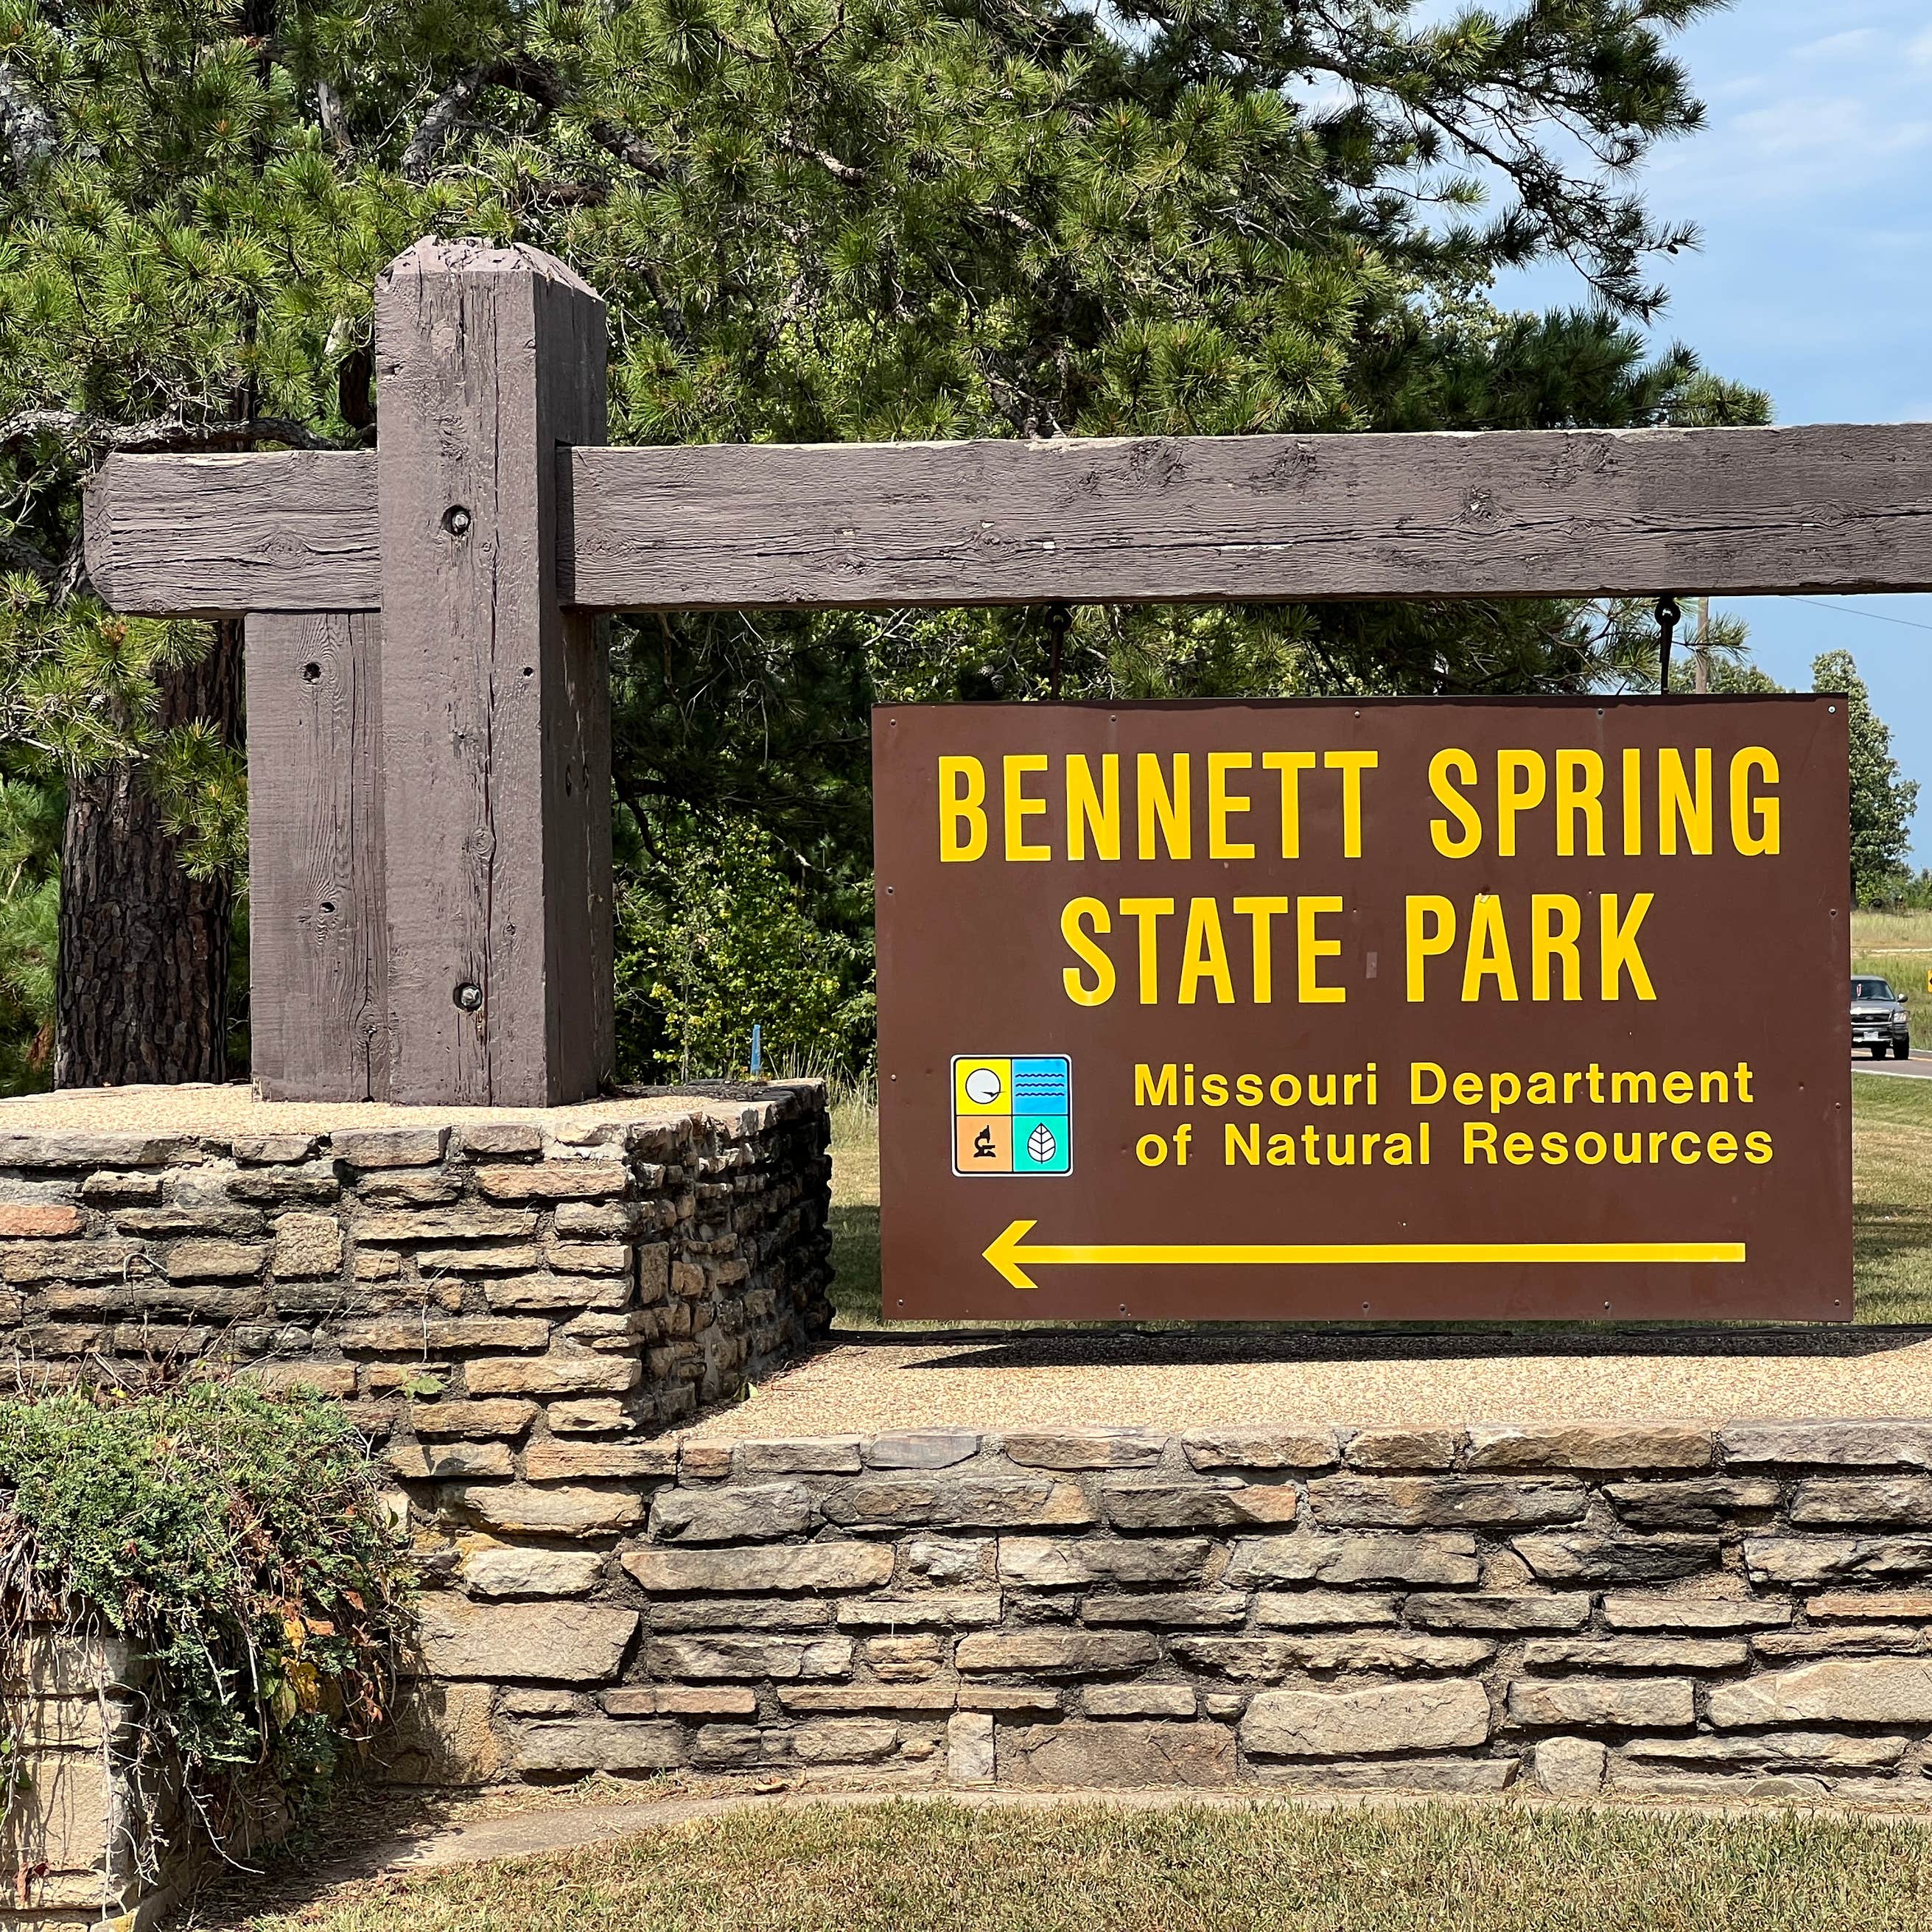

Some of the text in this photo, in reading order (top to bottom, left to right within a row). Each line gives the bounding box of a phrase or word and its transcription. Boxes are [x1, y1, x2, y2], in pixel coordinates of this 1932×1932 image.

[938, 746, 1782, 863] BENNETT SPRING
[1061, 892, 1657, 1007] STATE PARK
[1134, 1062, 1754, 1113] Missouri Department
[1135, 1121, 1774, 1167] of Natural Resources
